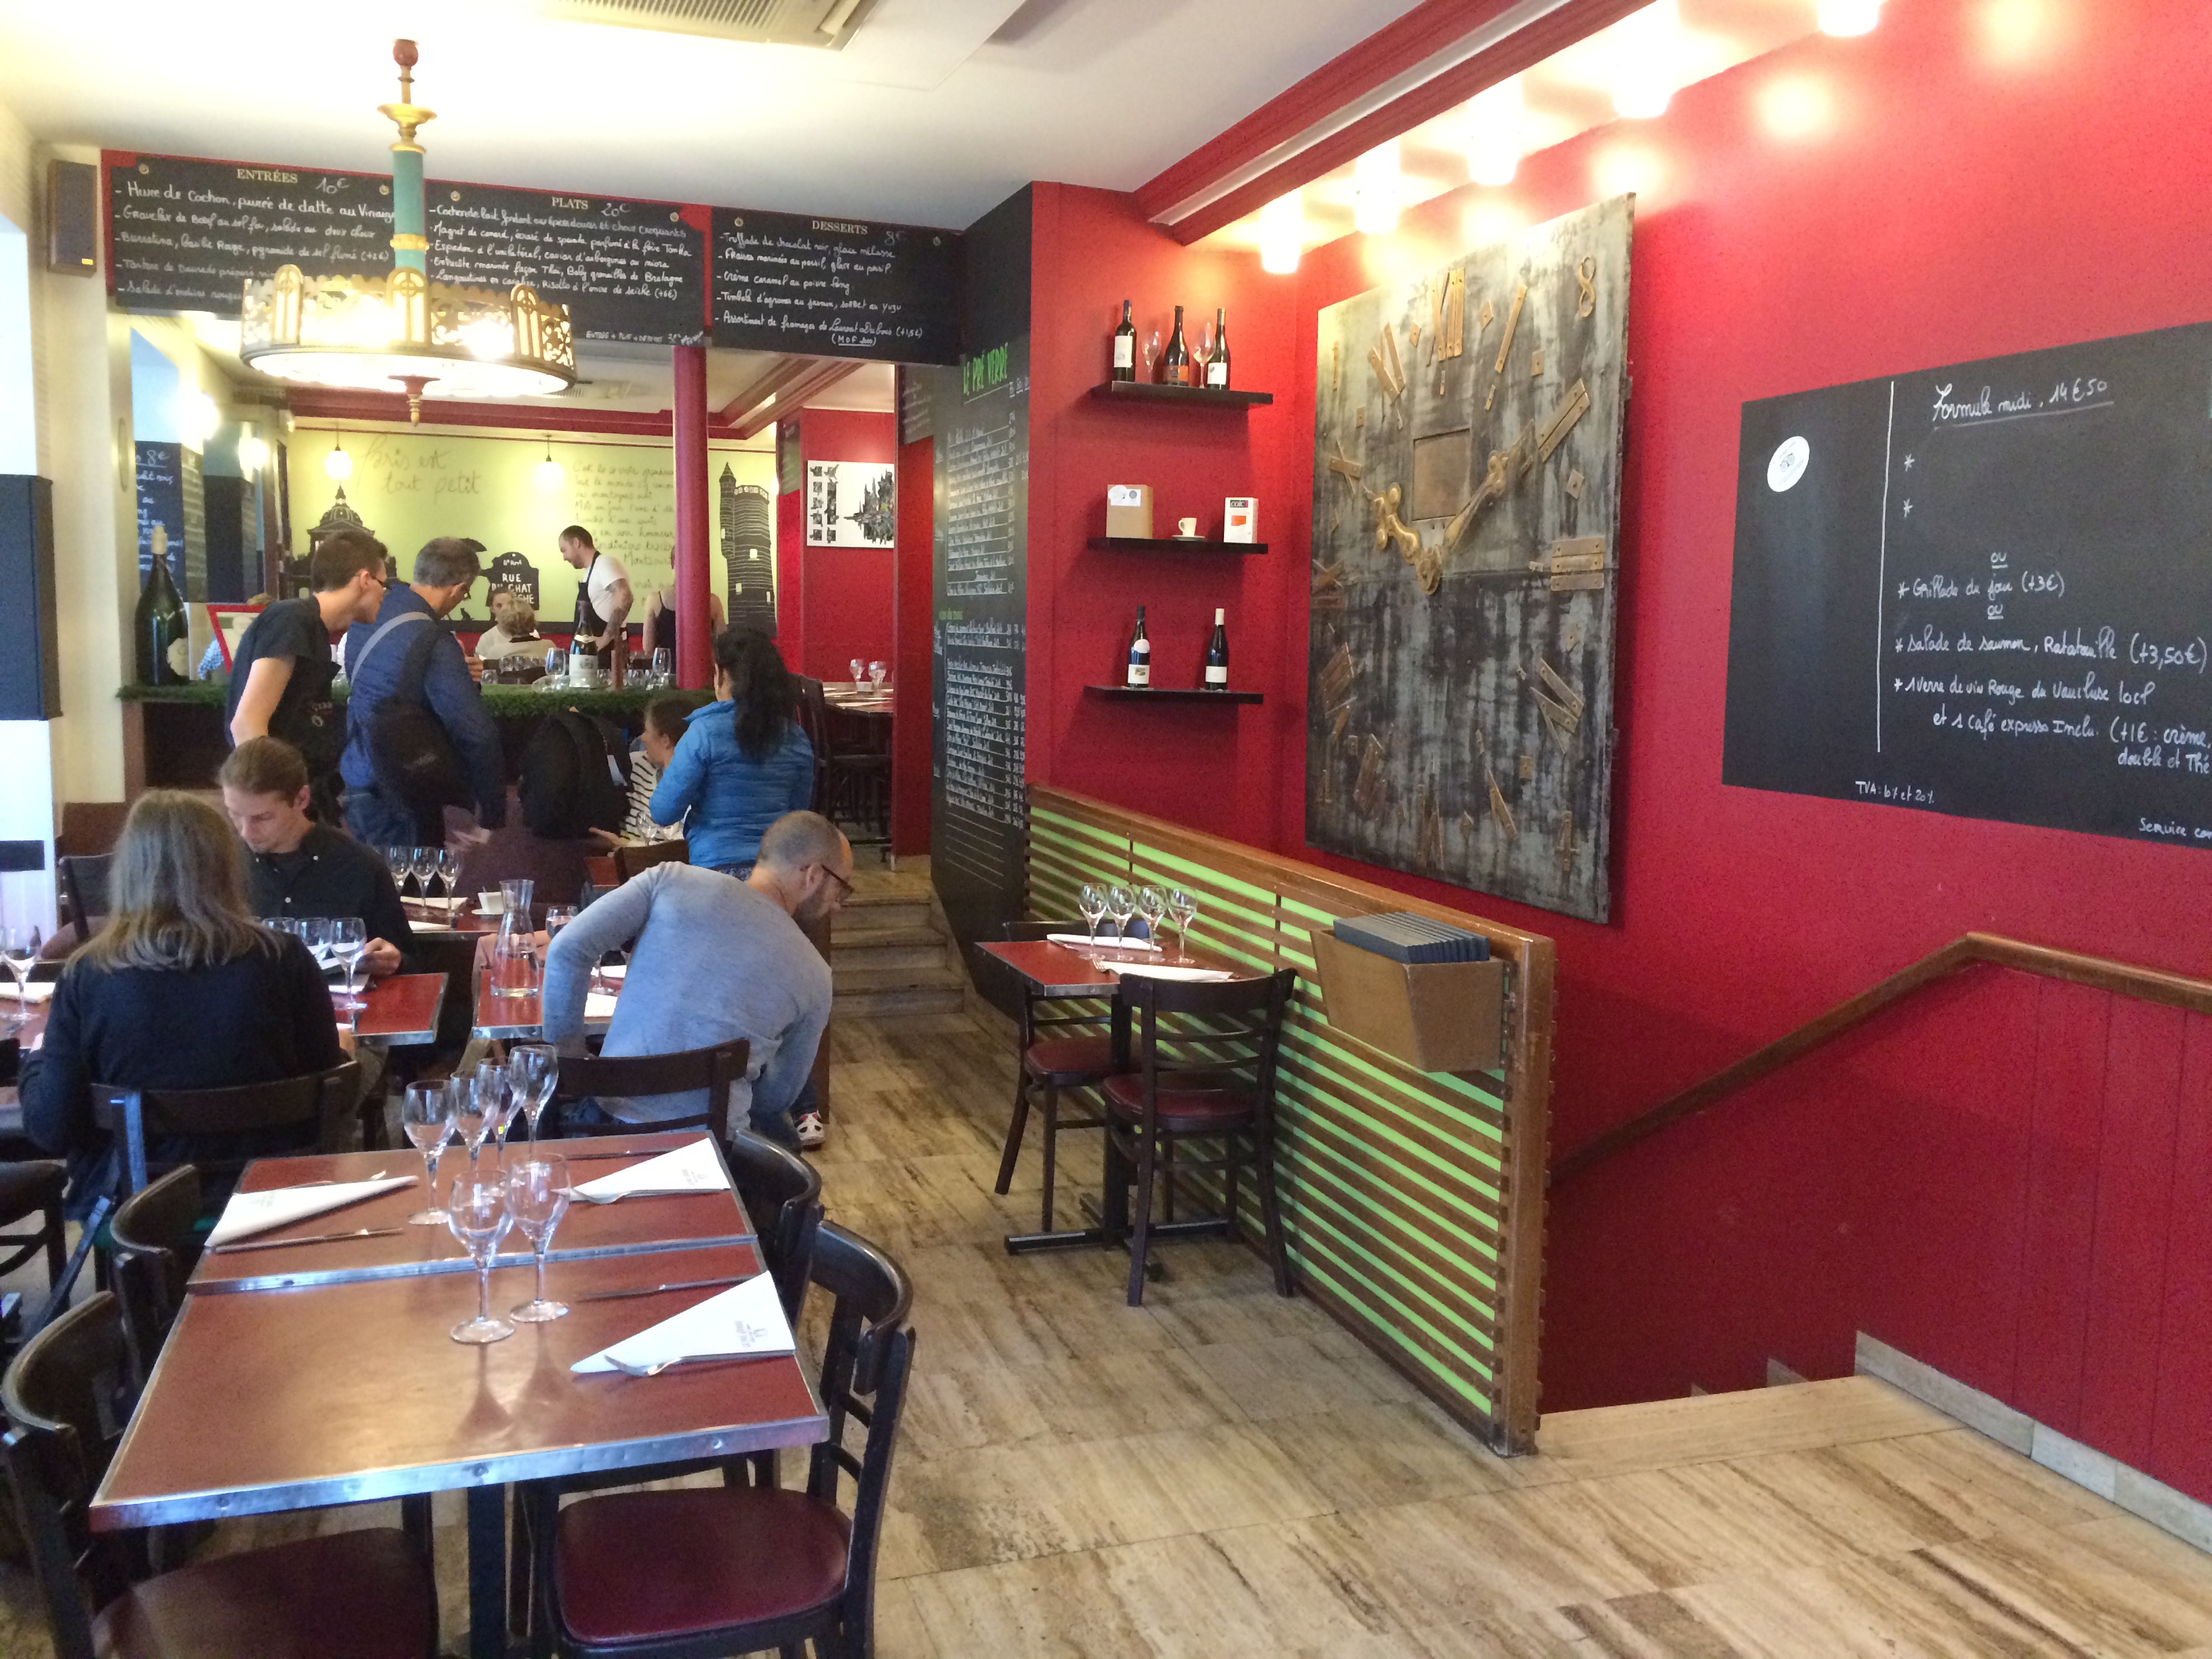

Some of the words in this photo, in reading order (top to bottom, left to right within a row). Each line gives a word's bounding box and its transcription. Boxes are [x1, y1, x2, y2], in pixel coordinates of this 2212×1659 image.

[236, 168, 298, 184] ENTRÉES
[163, 183, 182, 199] de
[279, 198, 295, 211] de
[298, 199, 334, 214] datte
[339, 207, 356, 217] au
[552, 197, 589, 210] PLATS
[812, 220, 868, 234] DESSERTS
[468, 226, 477, 237] de
[543, 232, 554, 243] de
[661, 242, 693, 258] Tonka
[762, 234, 775, 246] de
[434, 239, 474, 254] Espadon
[544, 251, 574, 262] caviar
[513, 261, 537, 277] façon
[630, 271, 639, 281] de
[644, 270, 684, 288] Bretagne
[753, 274, 789, 285] caramel
[612, 284, 623, 294] de
[767, 315, 777, 327] de
[780, 314, 815, 333] fromages
[819, 320, 827, 331] de
[828, 317, 859, 332] Laurent
[1931, 382, 1993, 422] Formule
[382, 470, 422, 494] tout
[433, 470, 483, 505] petit
[1990, 552, 2007, 564] ou
[501, 573, 522, 583] RUE
[1965, 577, 1981, 596] du
[2022, 570, 2066, 599] (+3€)
[508, 583, 532, 594] CHAT
[1987, 603, 2003, 617] ou
[1957, 631, 1975, 652] de
[2044, 625, 2118, 660] Ratatouille
[2129, 632, 2208, 675] (+3,50€)
[1948, 673, 1964, 693] de
[1965, 680, 1984, 694] vin
[1988, 678, 2025, 706] Rouge
[2031, 679, 2047, 699] du
[2051, 670, 2110, 701] Vaucluse
[1932, 702, 1948, 726] et
[2117, 744, 2163, 766] double
[2167, 747, 2181, 769] et
[2184, 752, 2211, 775] Thé
[1900, 784, 1912, 802] et
[1914, 788, 1936, 804] 20%
